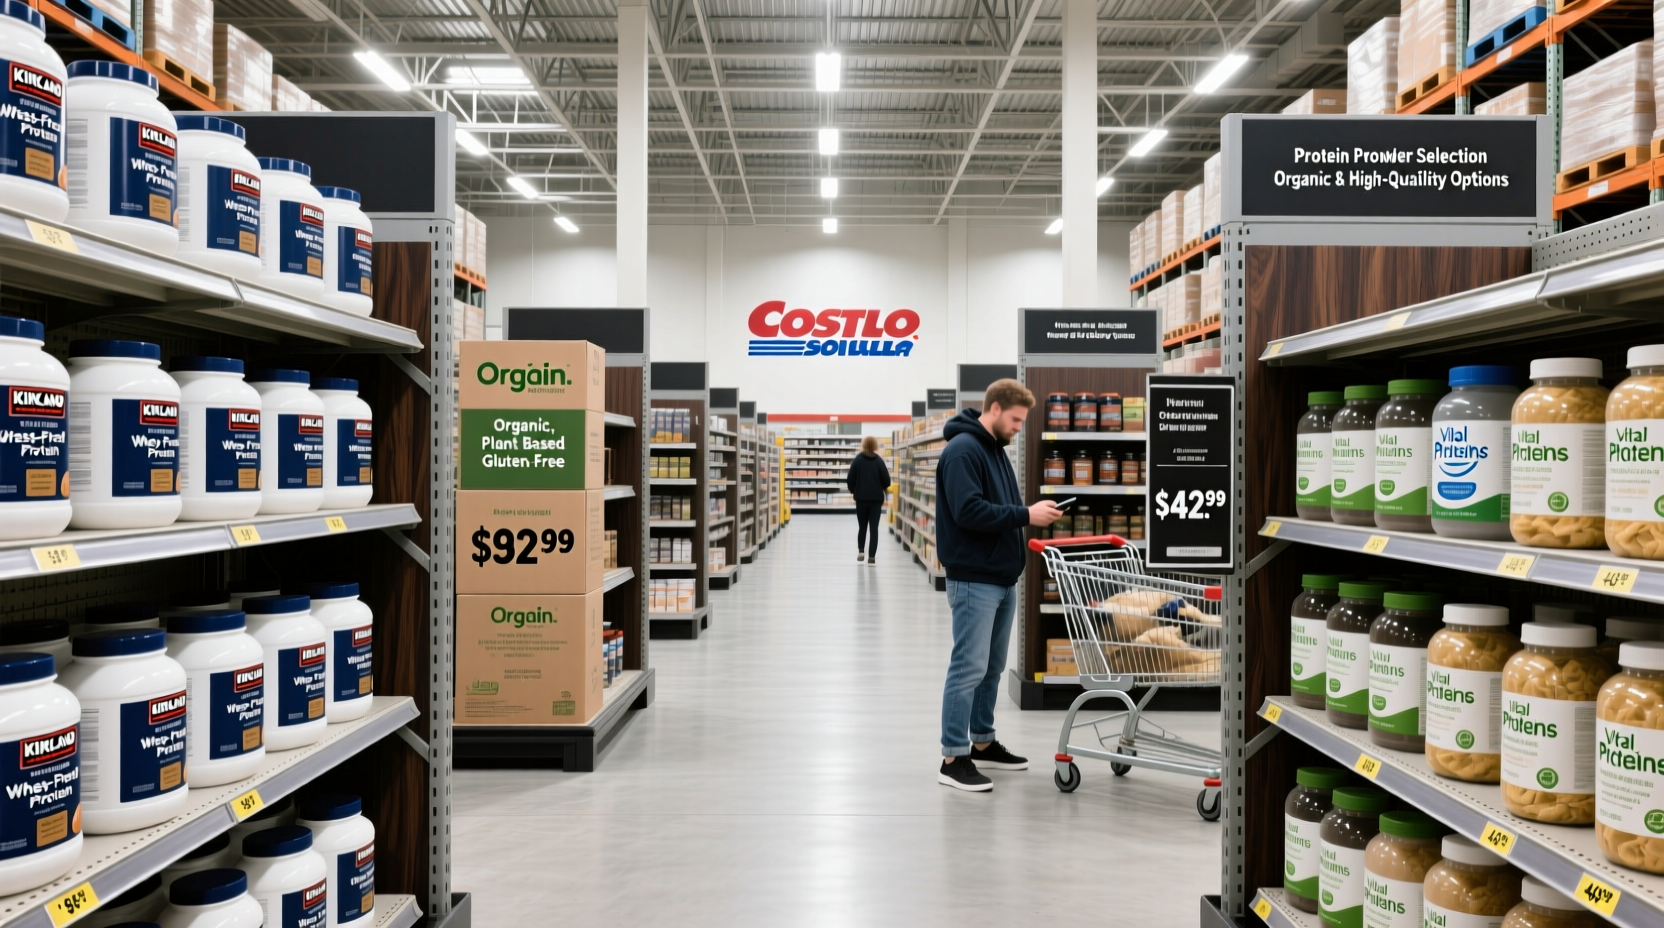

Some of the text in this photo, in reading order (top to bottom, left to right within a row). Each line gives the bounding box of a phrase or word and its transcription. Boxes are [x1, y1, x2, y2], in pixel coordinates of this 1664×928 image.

[1294, 147, 1350, 164] Protein
[1416, 146, 1487, 164] Selection
[1274, 169, 1332, 190] Organic
[1335, 170, 1345, 186] &
[1450, 170, 1509, 190] Options
[494, 417, 555, 435] Organic,
[481, 436, 565, 450] Plant Based
